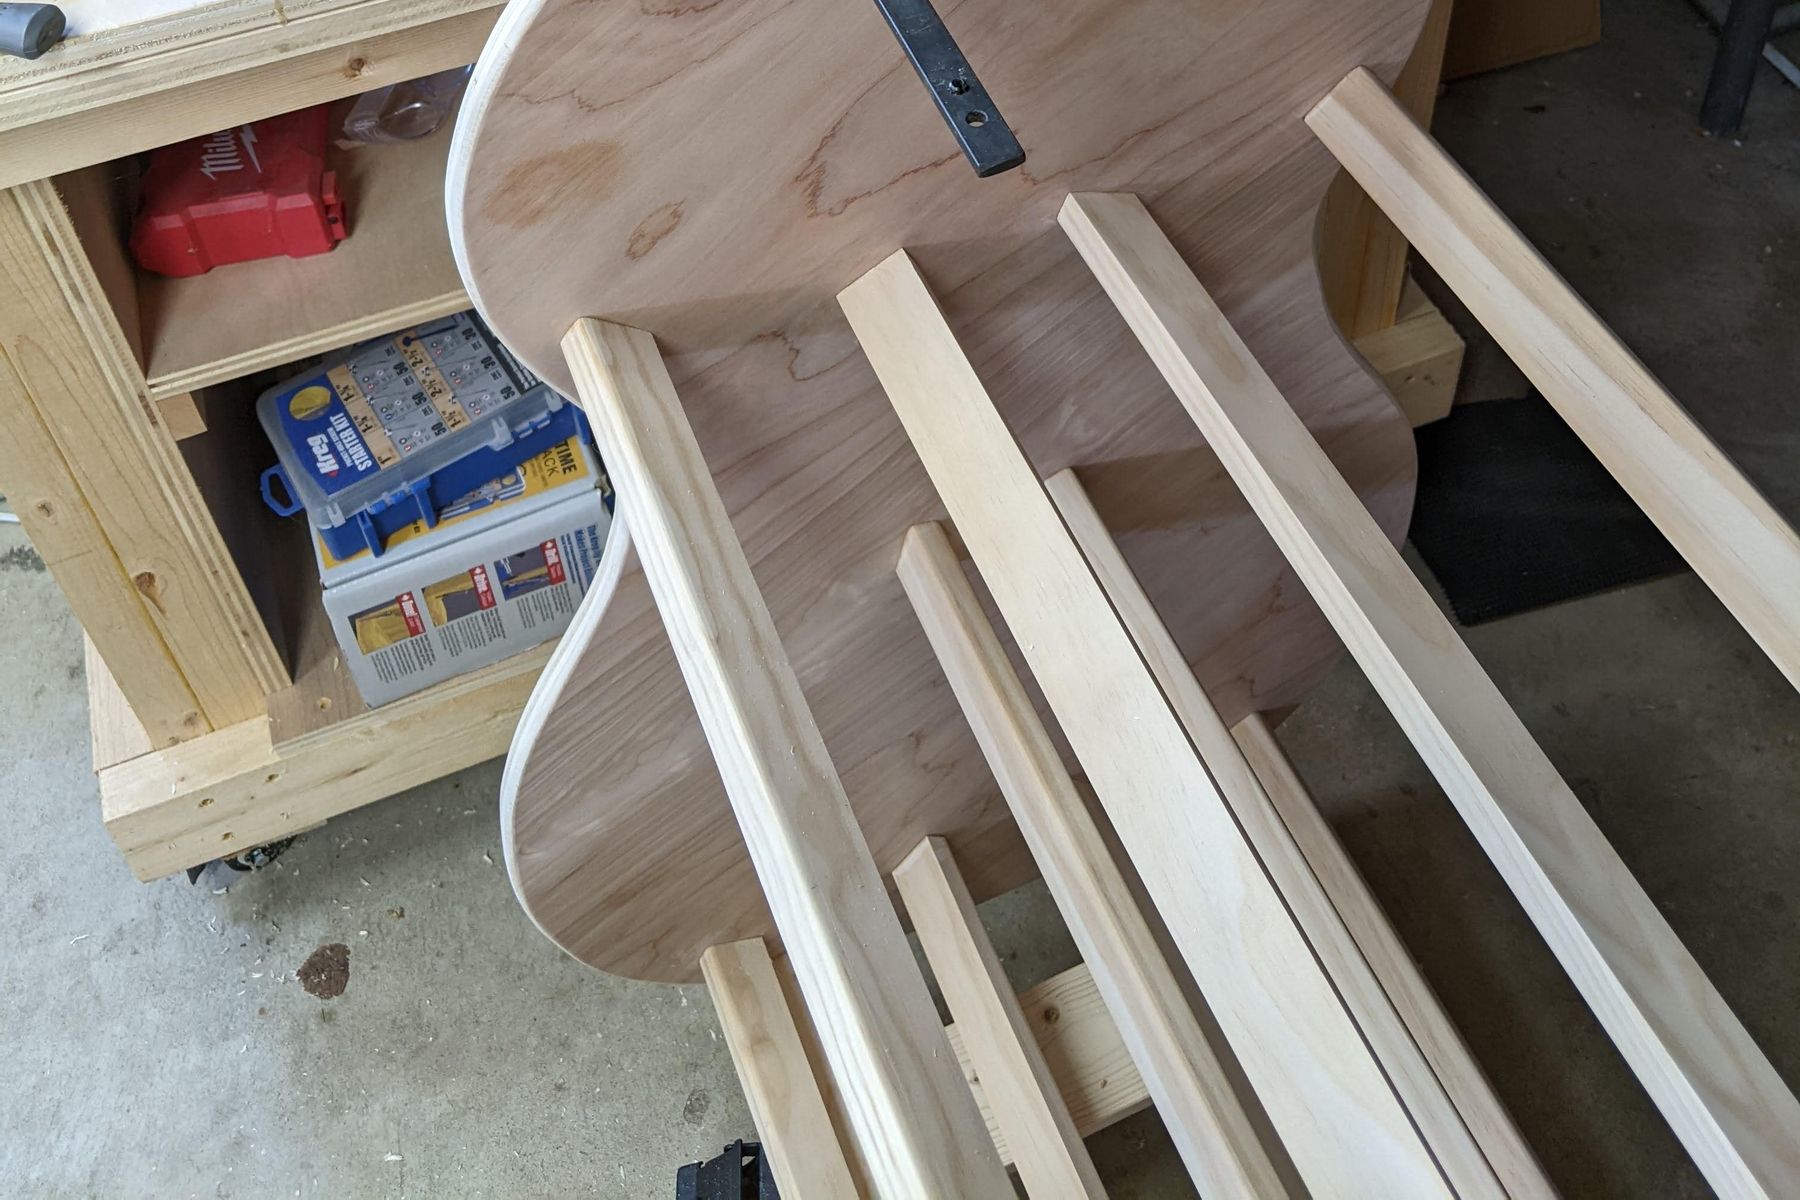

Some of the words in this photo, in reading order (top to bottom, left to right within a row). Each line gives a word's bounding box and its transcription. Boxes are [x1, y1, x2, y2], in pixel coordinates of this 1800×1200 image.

[462, 327, 477, 341] 30
[393, 362, 409, 376] 50
[481, 355, 496, 369] 30
[412, 392, 427, 406] 50
[500, 385, 516, 400] 50
[329, 412, 350, 432] KIT
[431, 421, 447, 436] 50
[307, 433, 340, 474] Kreg
[340, 427, 372, 471] STARTER
[541, 450, 561, 477] ACK
